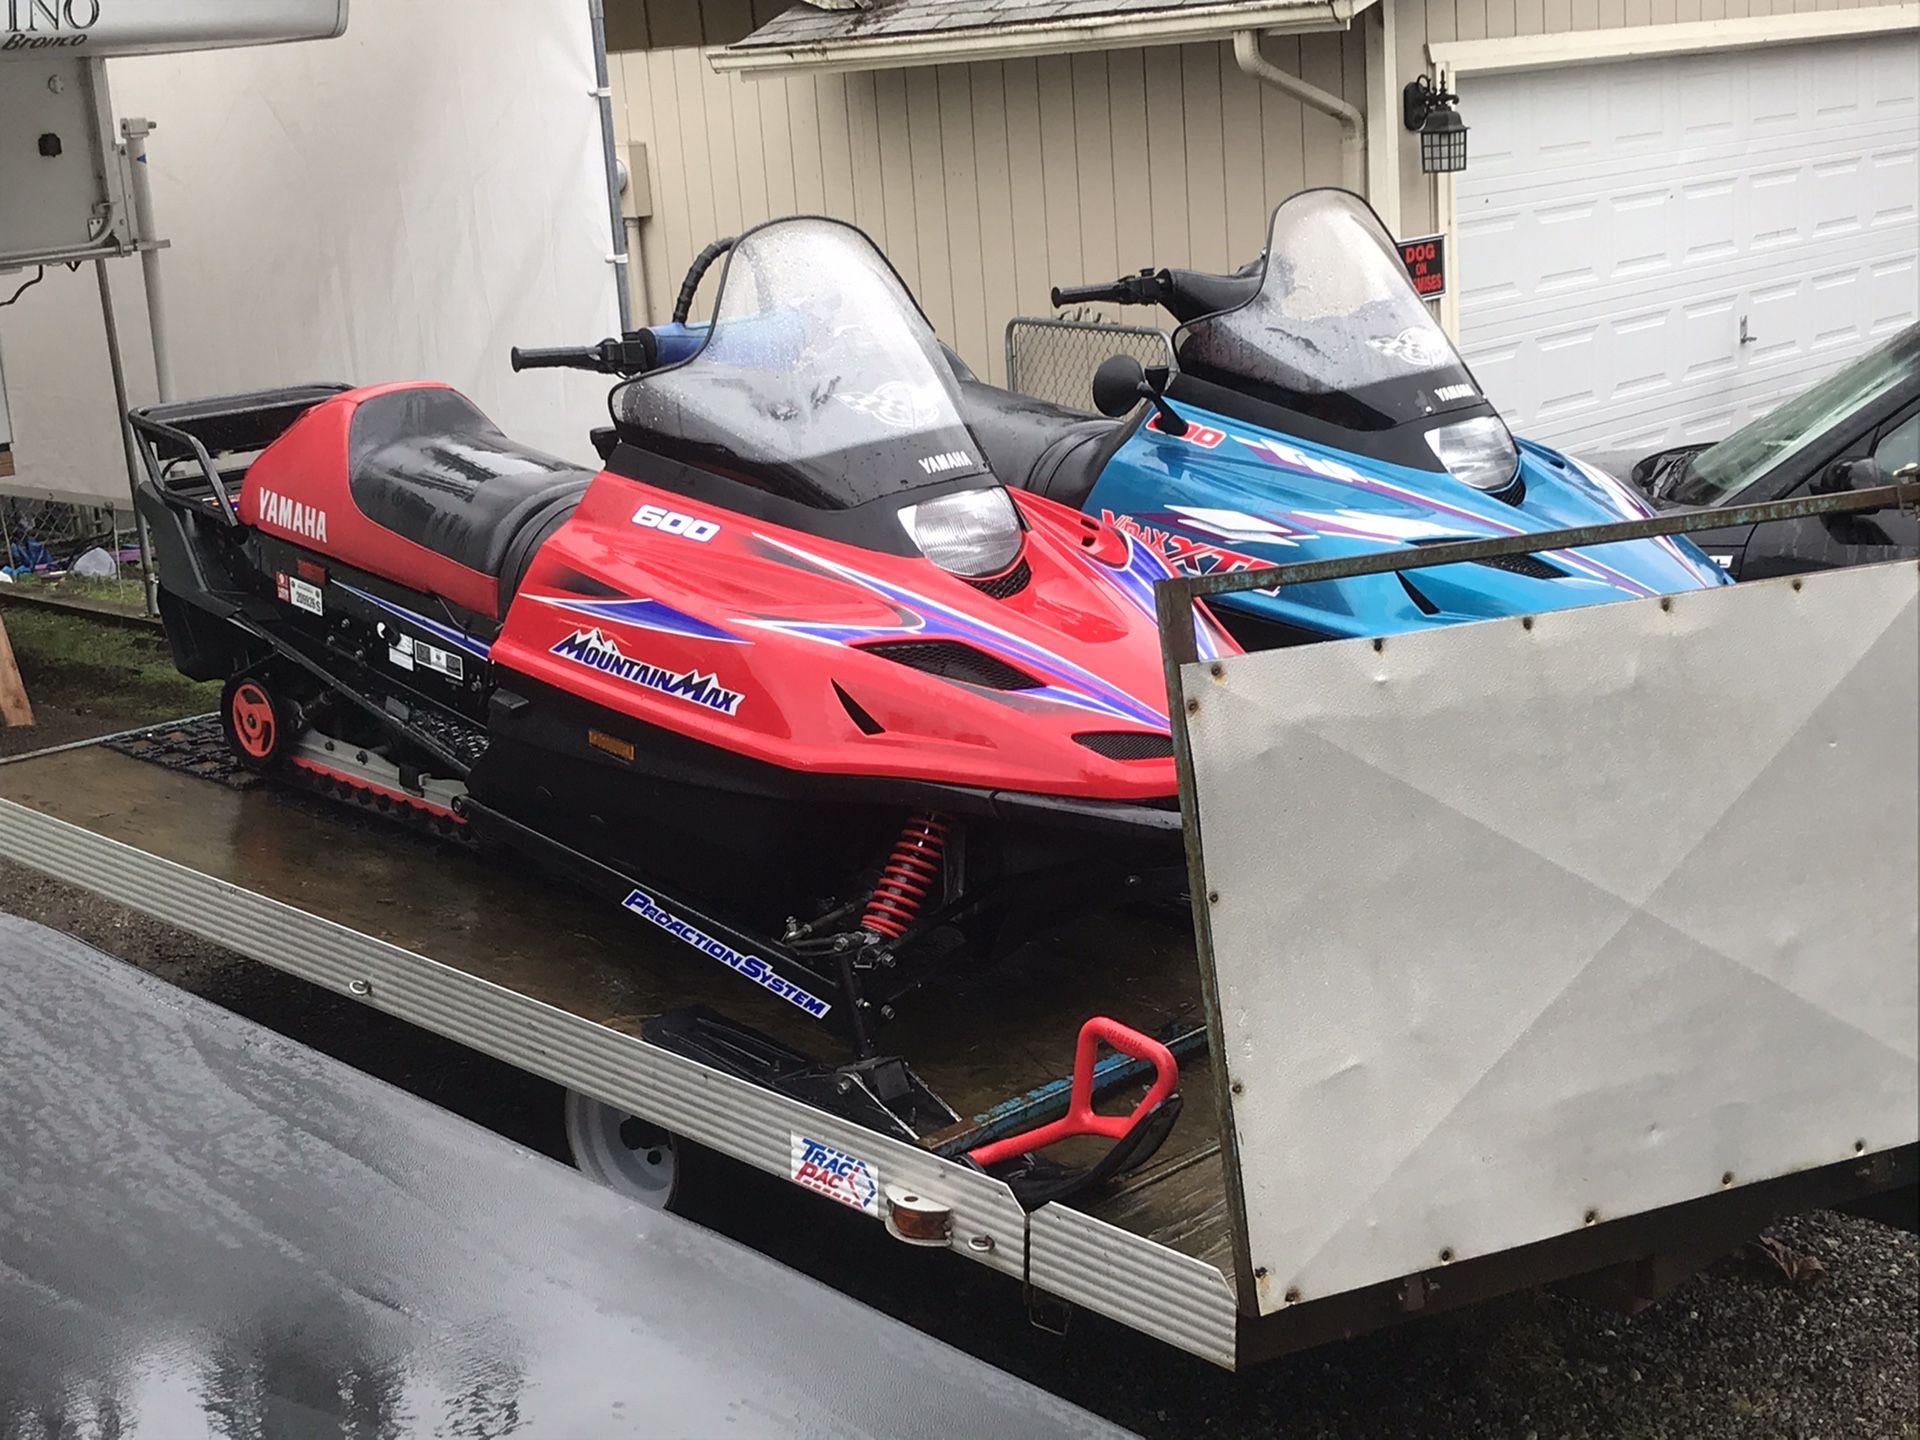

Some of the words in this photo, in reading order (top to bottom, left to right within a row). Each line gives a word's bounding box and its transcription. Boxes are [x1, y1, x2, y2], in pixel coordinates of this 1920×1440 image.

[1, 33, 88, 51] Bronco
[1405, 243, 1435, 263] DOG
[1415, 262, 1427, 275] ON
[917, 450, 973, 474] YAMAHA
[259, 486, 328, 544] YAMAHA
[631, 503, 721, 543] 600
[795, 1161, 845, 1189] PAC
